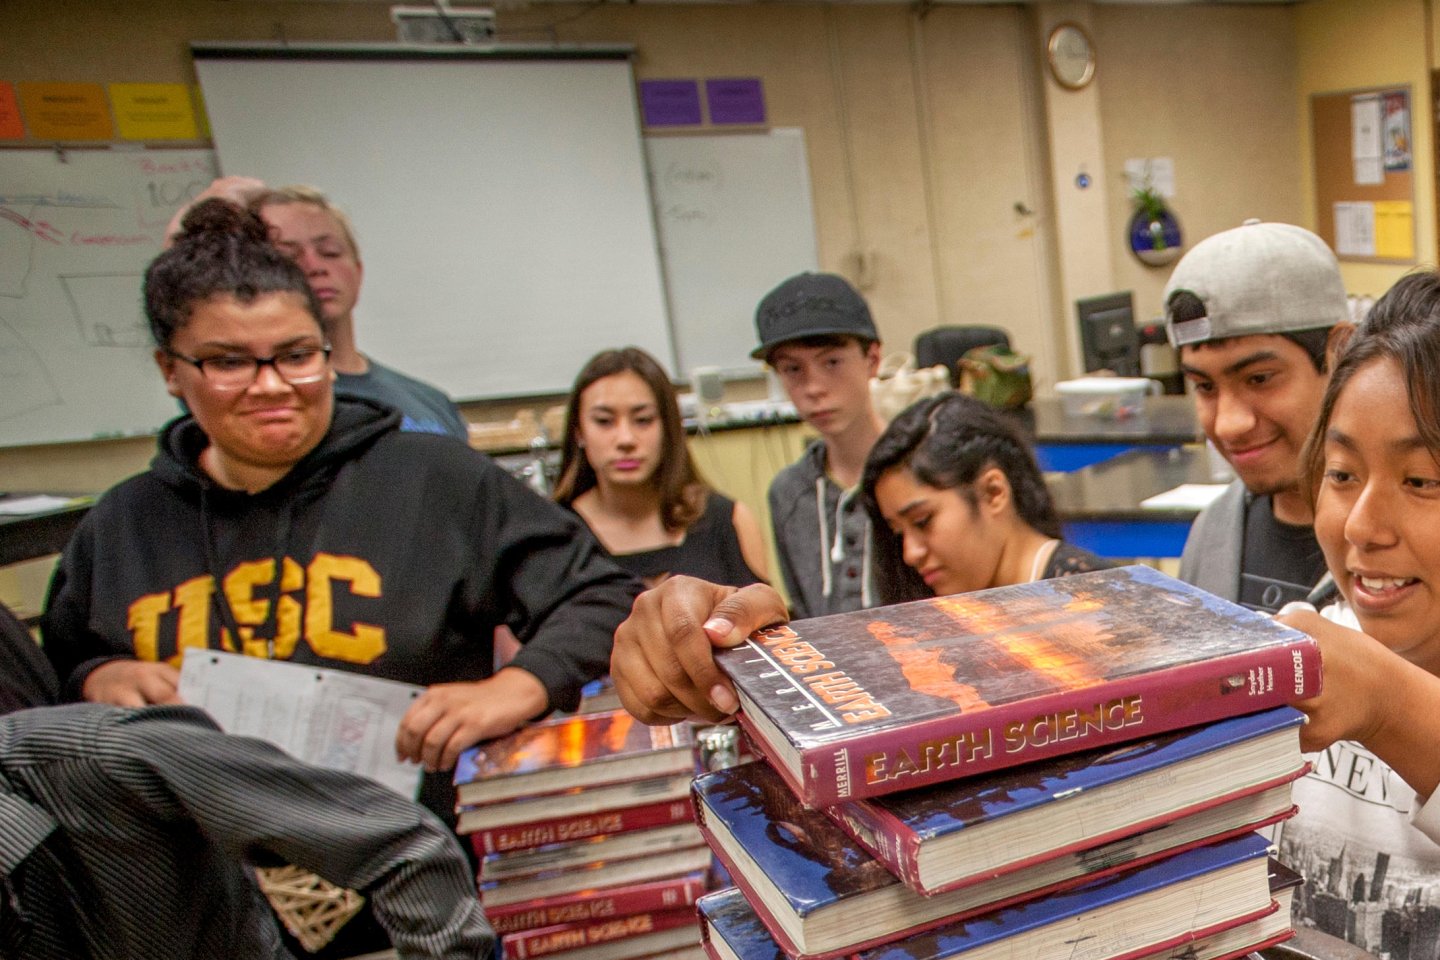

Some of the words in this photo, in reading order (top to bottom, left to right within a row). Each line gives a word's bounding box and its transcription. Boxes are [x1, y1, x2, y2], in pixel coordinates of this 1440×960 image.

[127, 551, 388, 670] USC
[756, 625, 836, 674] SCIENCE
[1292, 649, 1304, 695] GLENCOE
[732, 644, 837, 732] MERRIL
[803, 671, 892, 724] EARTH
[865, 726, 992, 785] EARTH
[1004, 695, 1144, 753] SCIENCE
[834, 748, 847, 798] MERRILL
